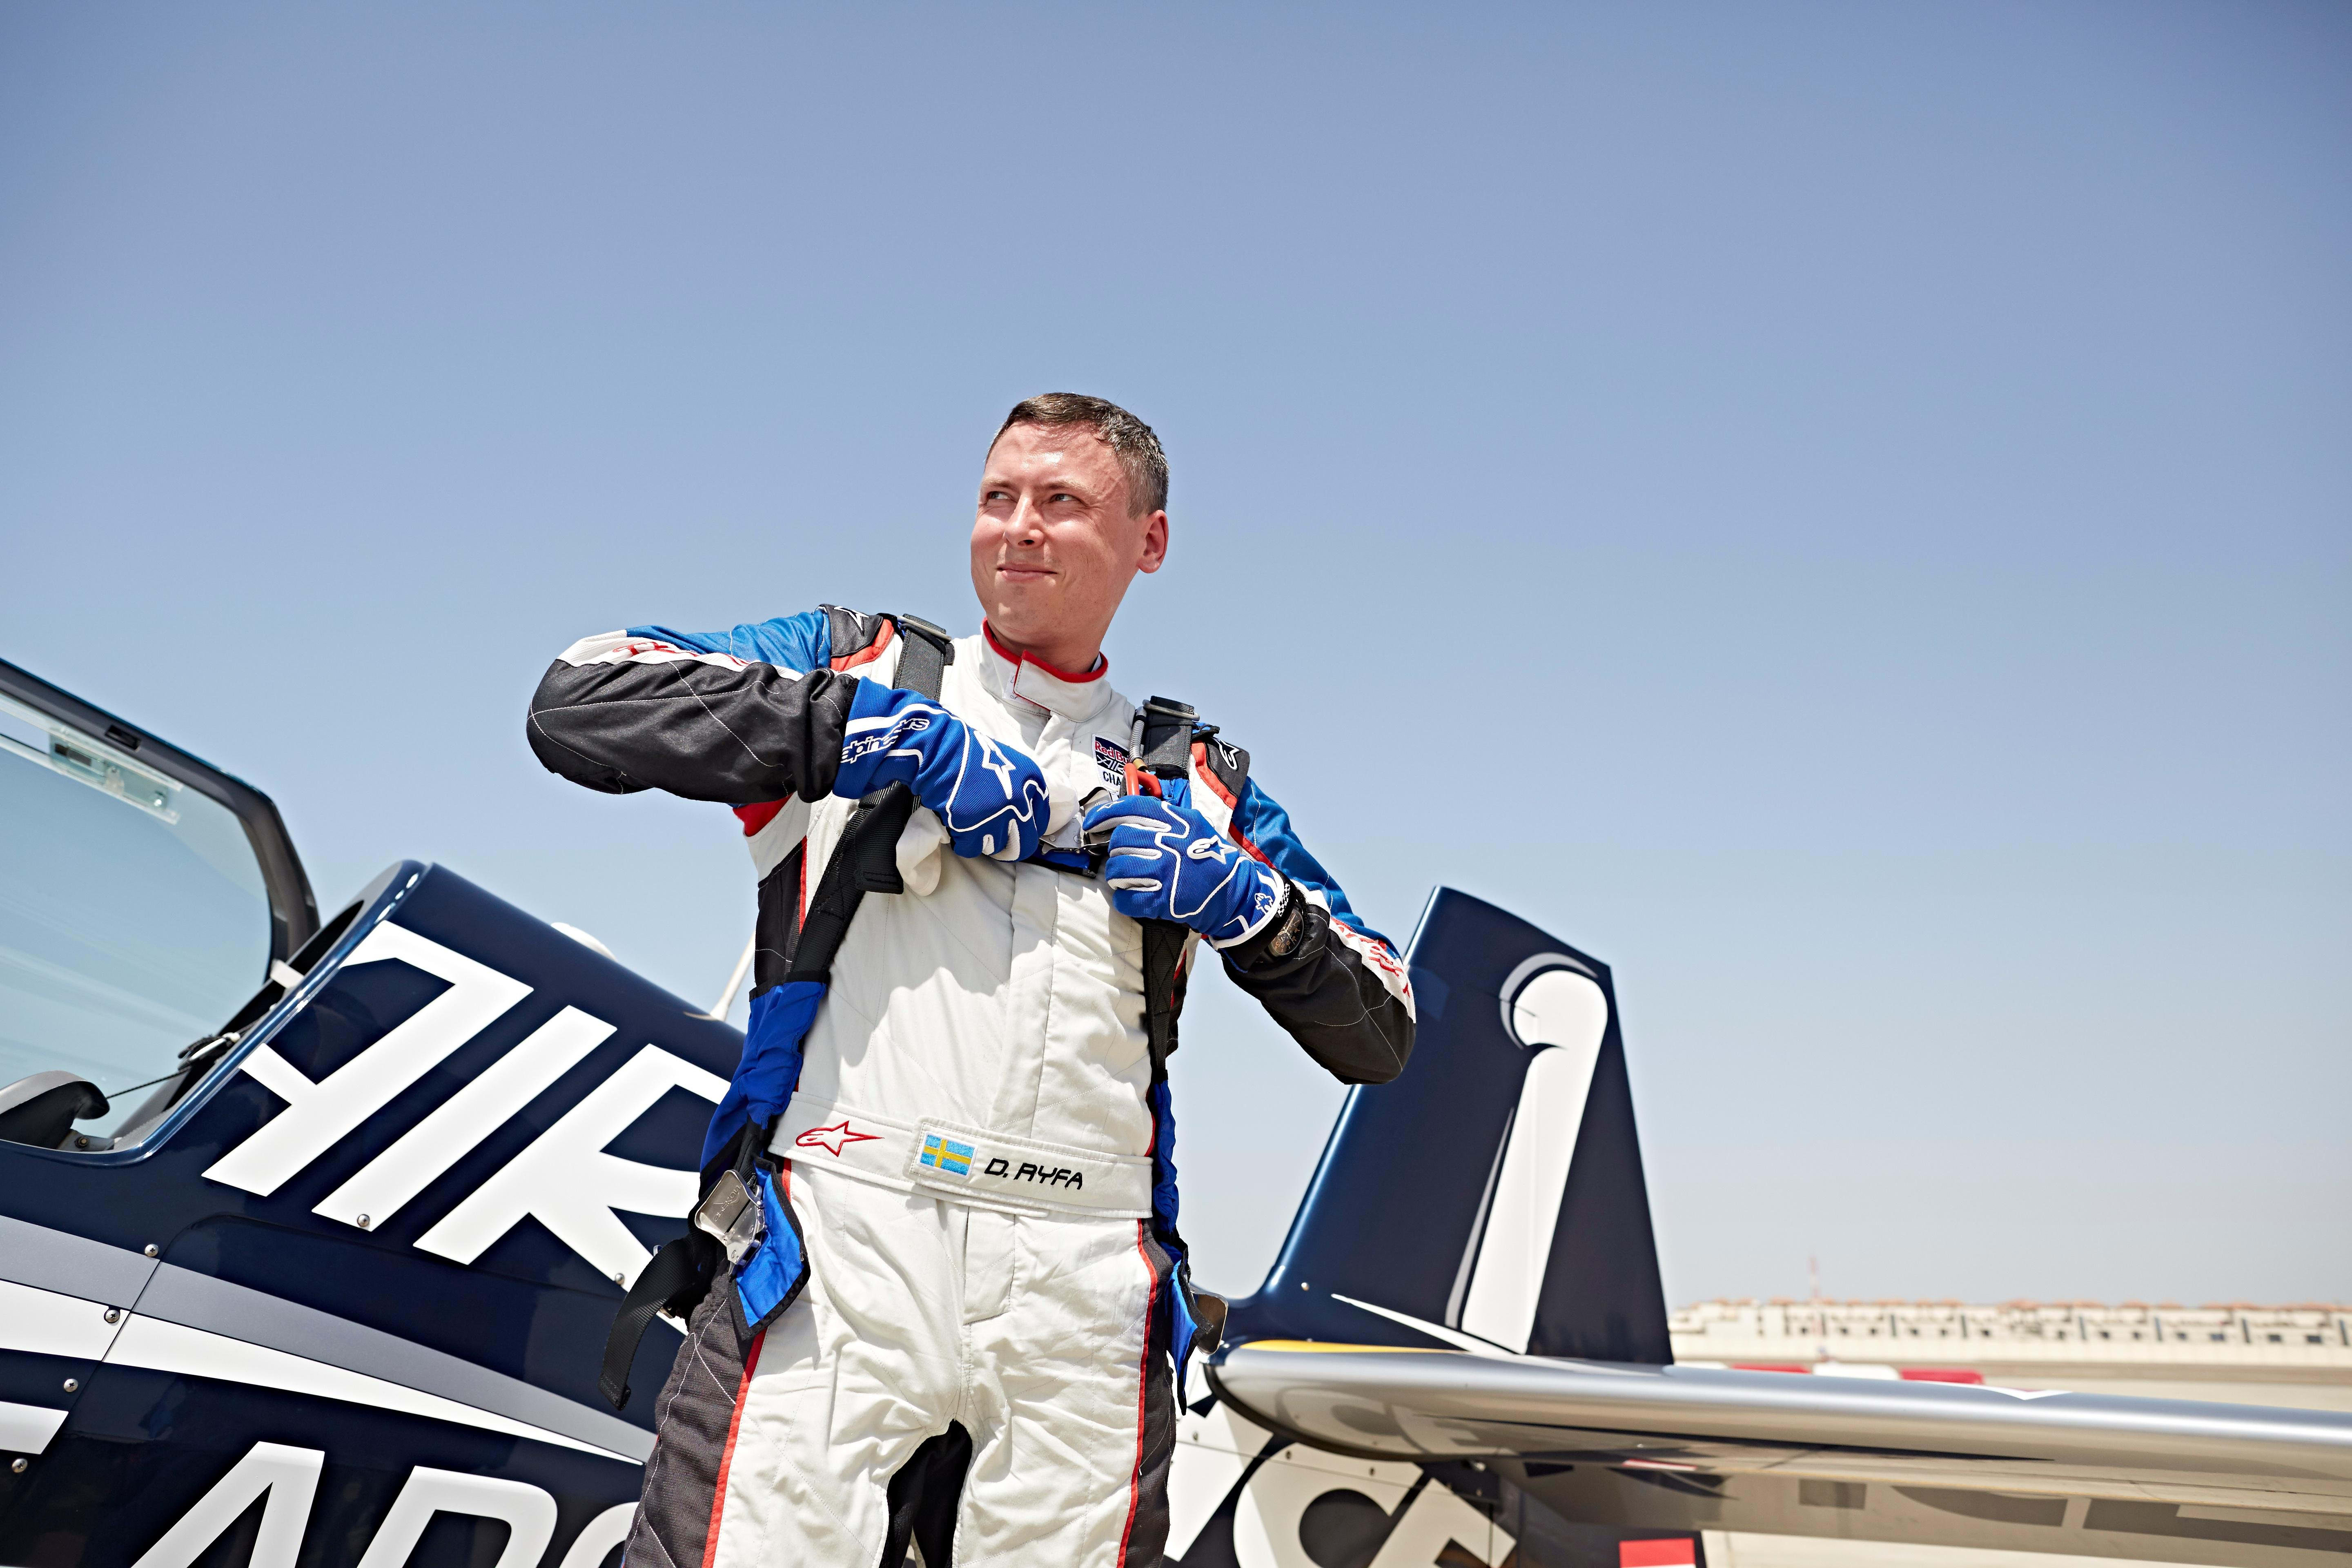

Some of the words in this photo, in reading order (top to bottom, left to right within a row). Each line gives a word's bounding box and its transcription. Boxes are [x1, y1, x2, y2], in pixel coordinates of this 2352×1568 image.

[1095, 740, 1115, 760] Red
[1114, 749, 1130, 765] Bu
[984, 1158, 1009, 1178] D.
[1013, 1162, 1082, 1190] RYFA
